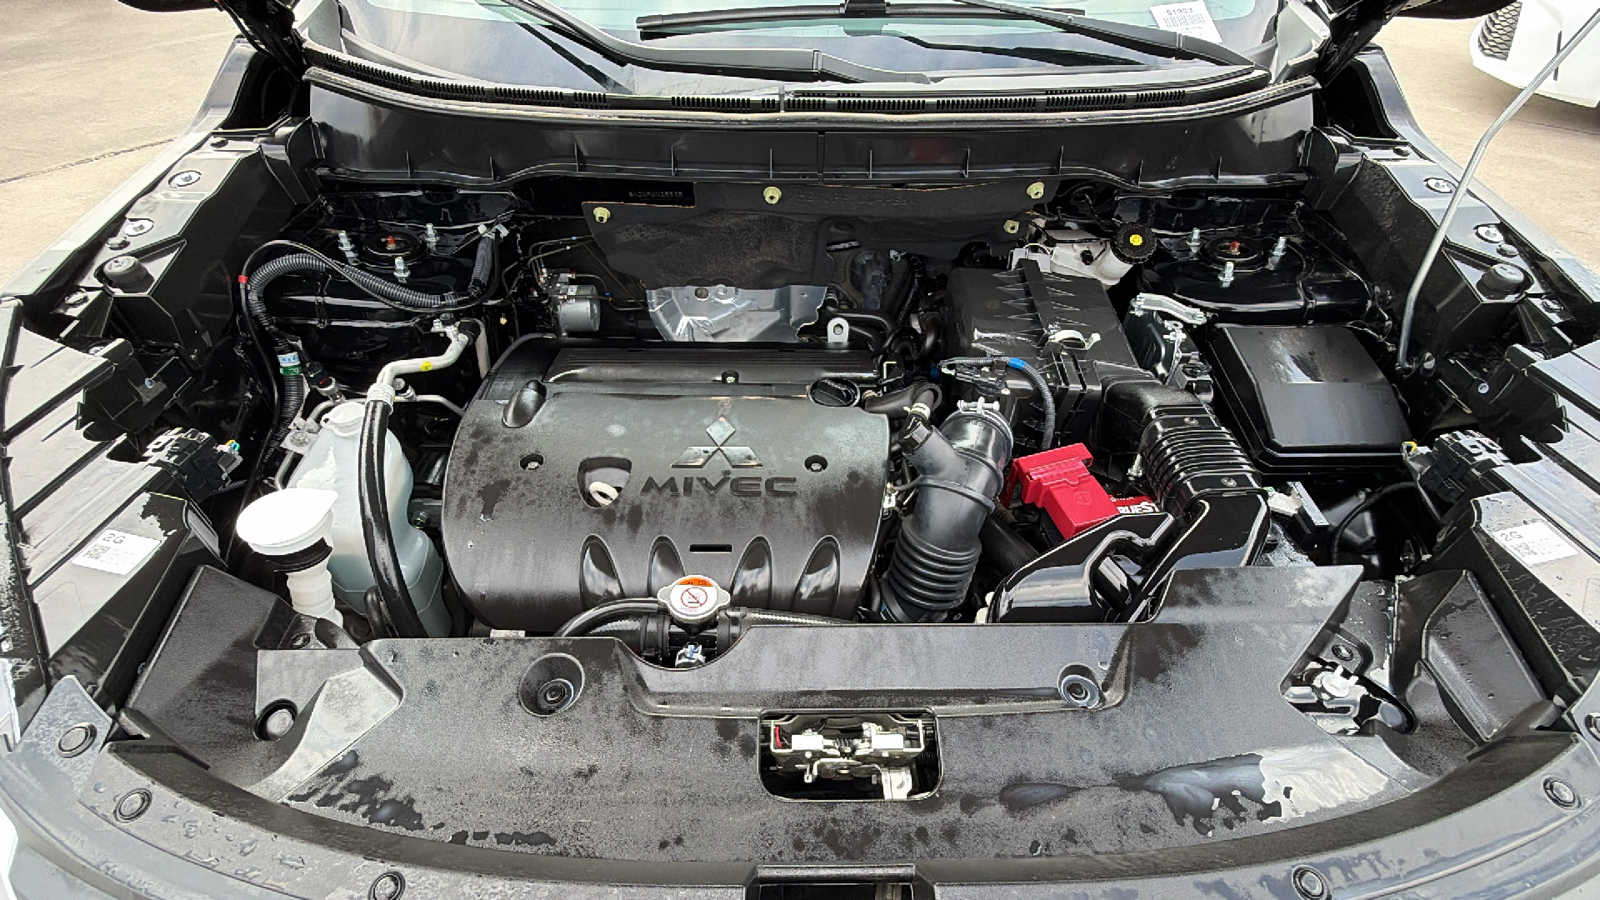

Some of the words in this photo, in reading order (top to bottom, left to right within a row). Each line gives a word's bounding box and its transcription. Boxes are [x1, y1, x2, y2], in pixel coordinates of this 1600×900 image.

[640, 476, 797, 497] MIVEC
[102, 532, 126, 544] 2G
[1500, 531, 1524, 542] 2G
